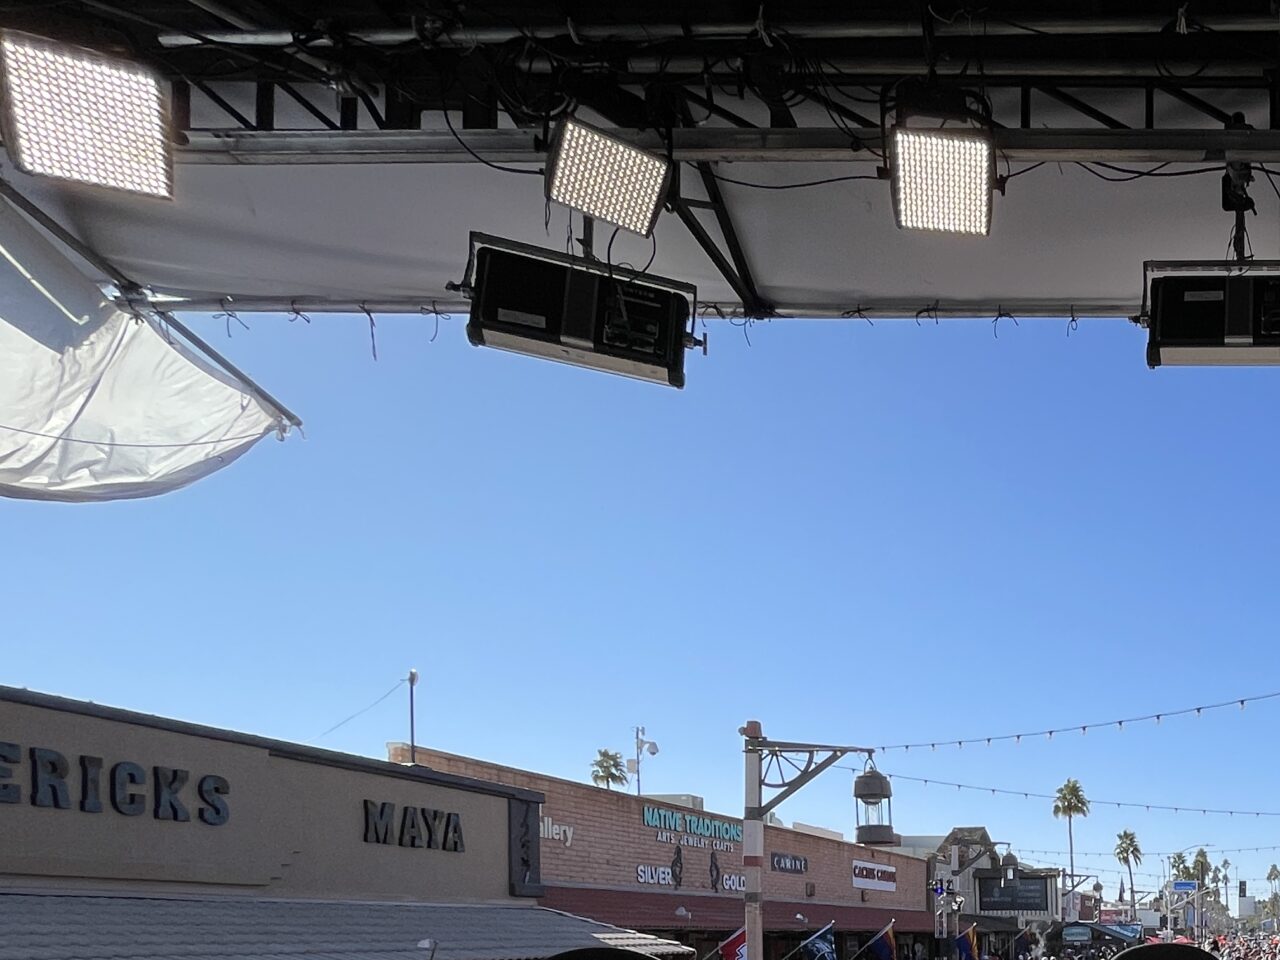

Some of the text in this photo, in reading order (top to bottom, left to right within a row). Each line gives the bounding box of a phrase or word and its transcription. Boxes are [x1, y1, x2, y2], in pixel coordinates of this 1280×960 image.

[363, 799, 466, 853] MAYA
[643, 805, 744, 842] NATIVE TRADITIONS
[656, 831, 734, 852] ARTS JEWELRY CRAFTS
[637, 865, 746, 891] SILVER GOLD
